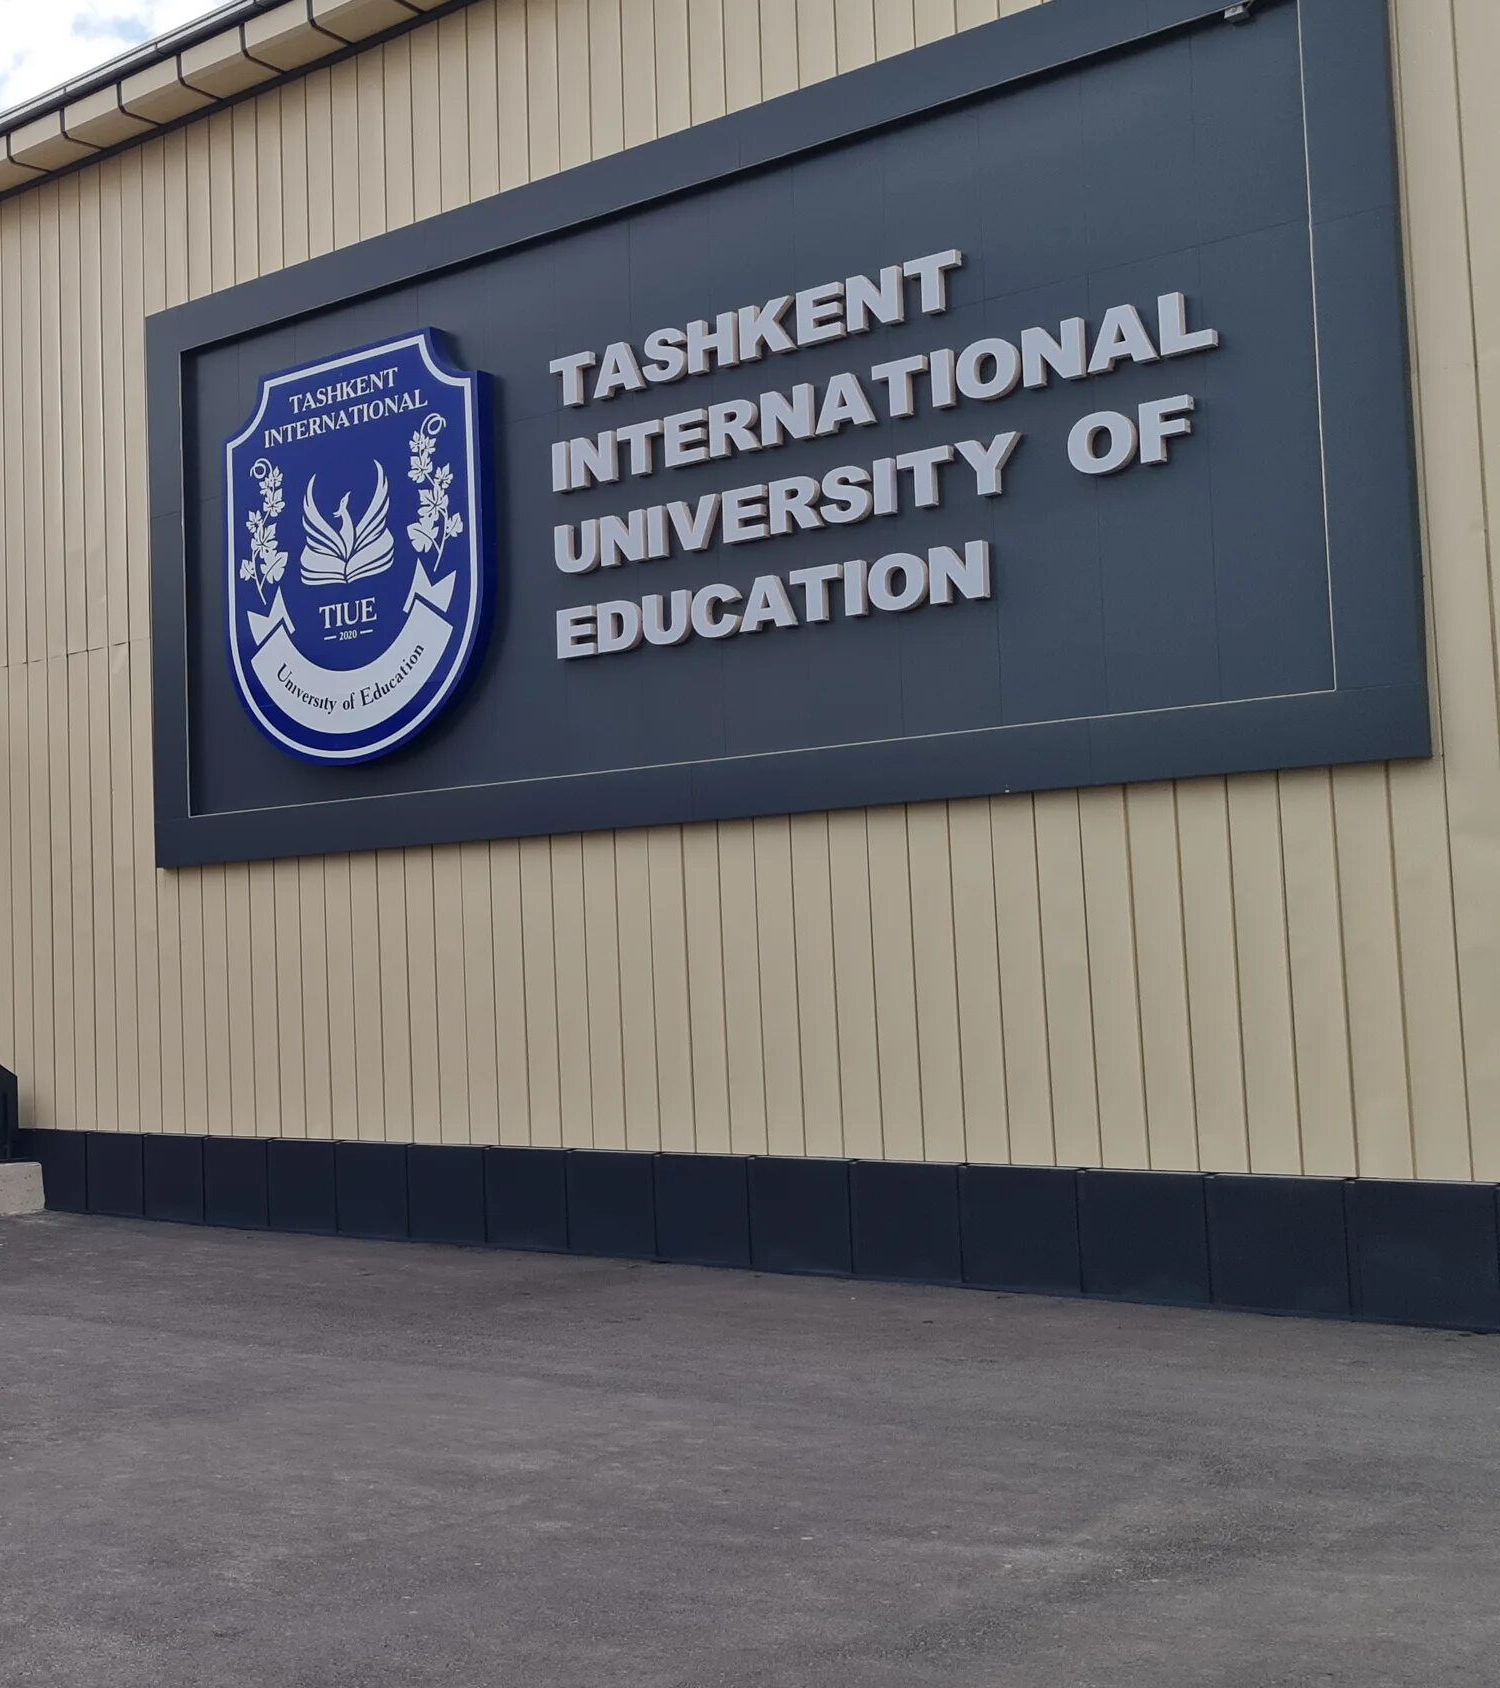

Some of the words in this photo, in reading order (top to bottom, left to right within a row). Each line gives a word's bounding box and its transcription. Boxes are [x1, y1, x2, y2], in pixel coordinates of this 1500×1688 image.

[549, 249, 963, 407] TASHKENT
[264, 389, 428, 449] INTERNATIONAL
[289, 367, 398, 414] TASHKENT
[551, 291, 1219, 492] INTERNATIONAL
[553, 431, 1021, 574] UNIVERSITY
[1067, 394, 1196, 475] OF
[319, 597, 377, 629] TIUE
[556, 540, 990, 660] EDUCATION
[339, 630, 357, 641] 2020
[276, 663, 337, 714] University
[342, 691, 357, 711] of
[361, 644, 425, 706] Education
